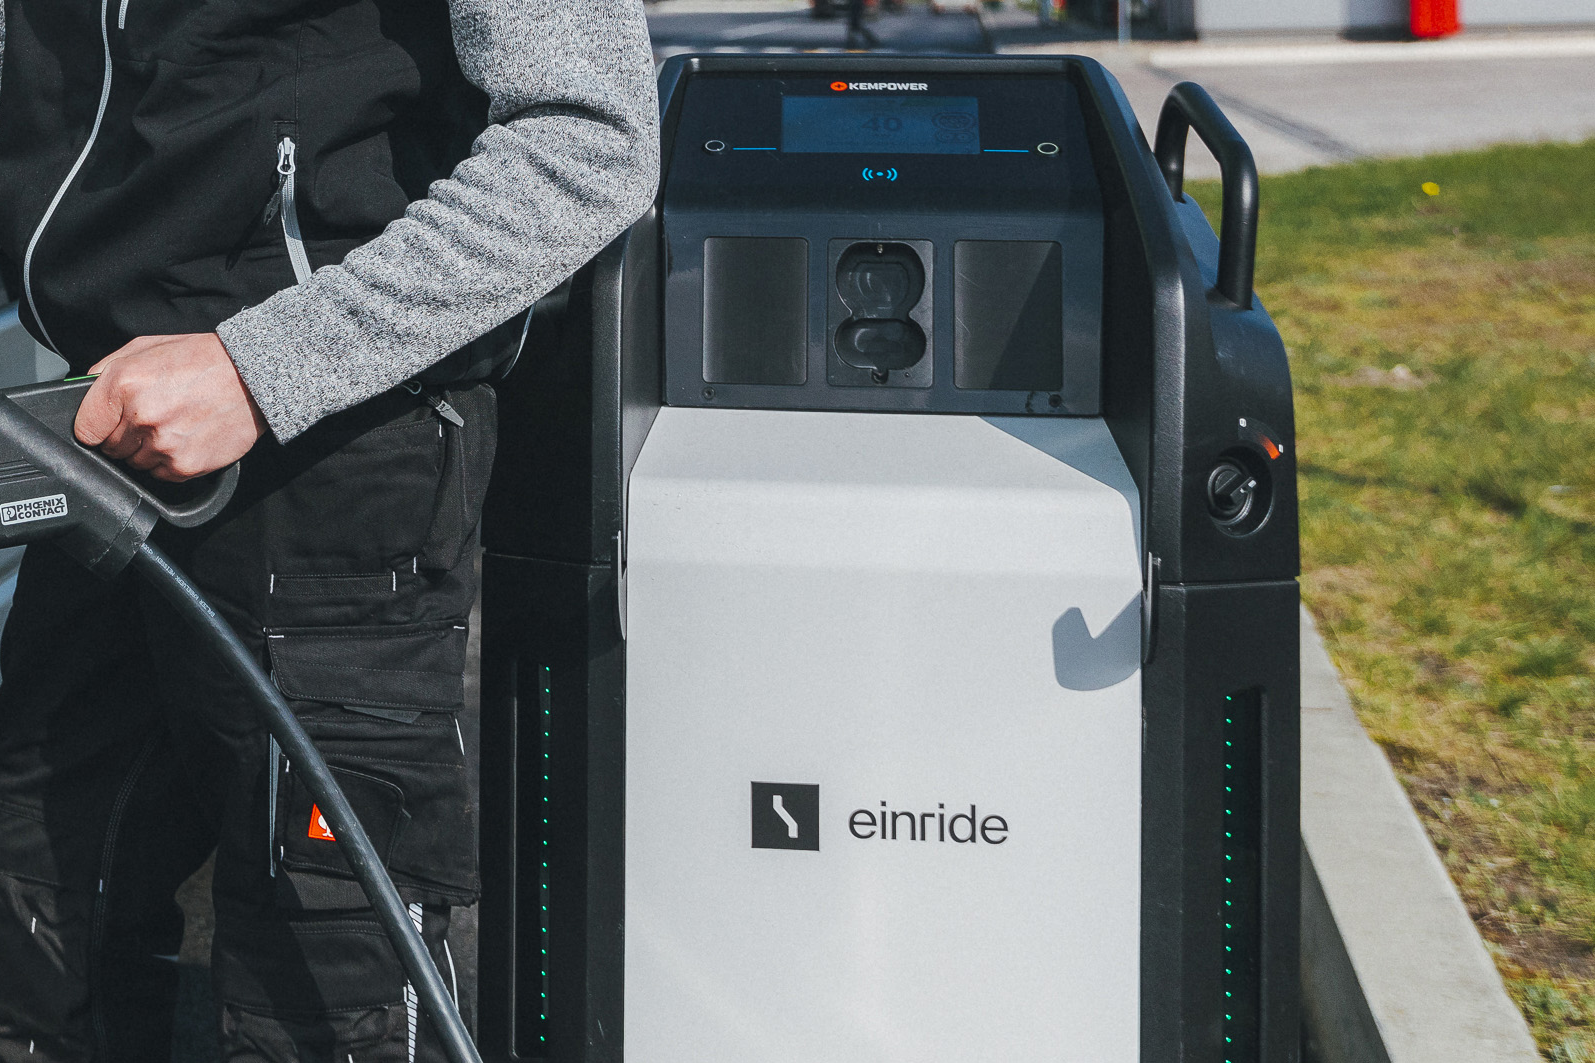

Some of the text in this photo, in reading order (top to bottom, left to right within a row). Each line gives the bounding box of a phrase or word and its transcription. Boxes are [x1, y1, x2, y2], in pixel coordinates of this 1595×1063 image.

[849, 82, 929, 91] KEMPOWER
[18, 505, 66, 520] CONTACT
[848, 800, 1009, 845] einride
